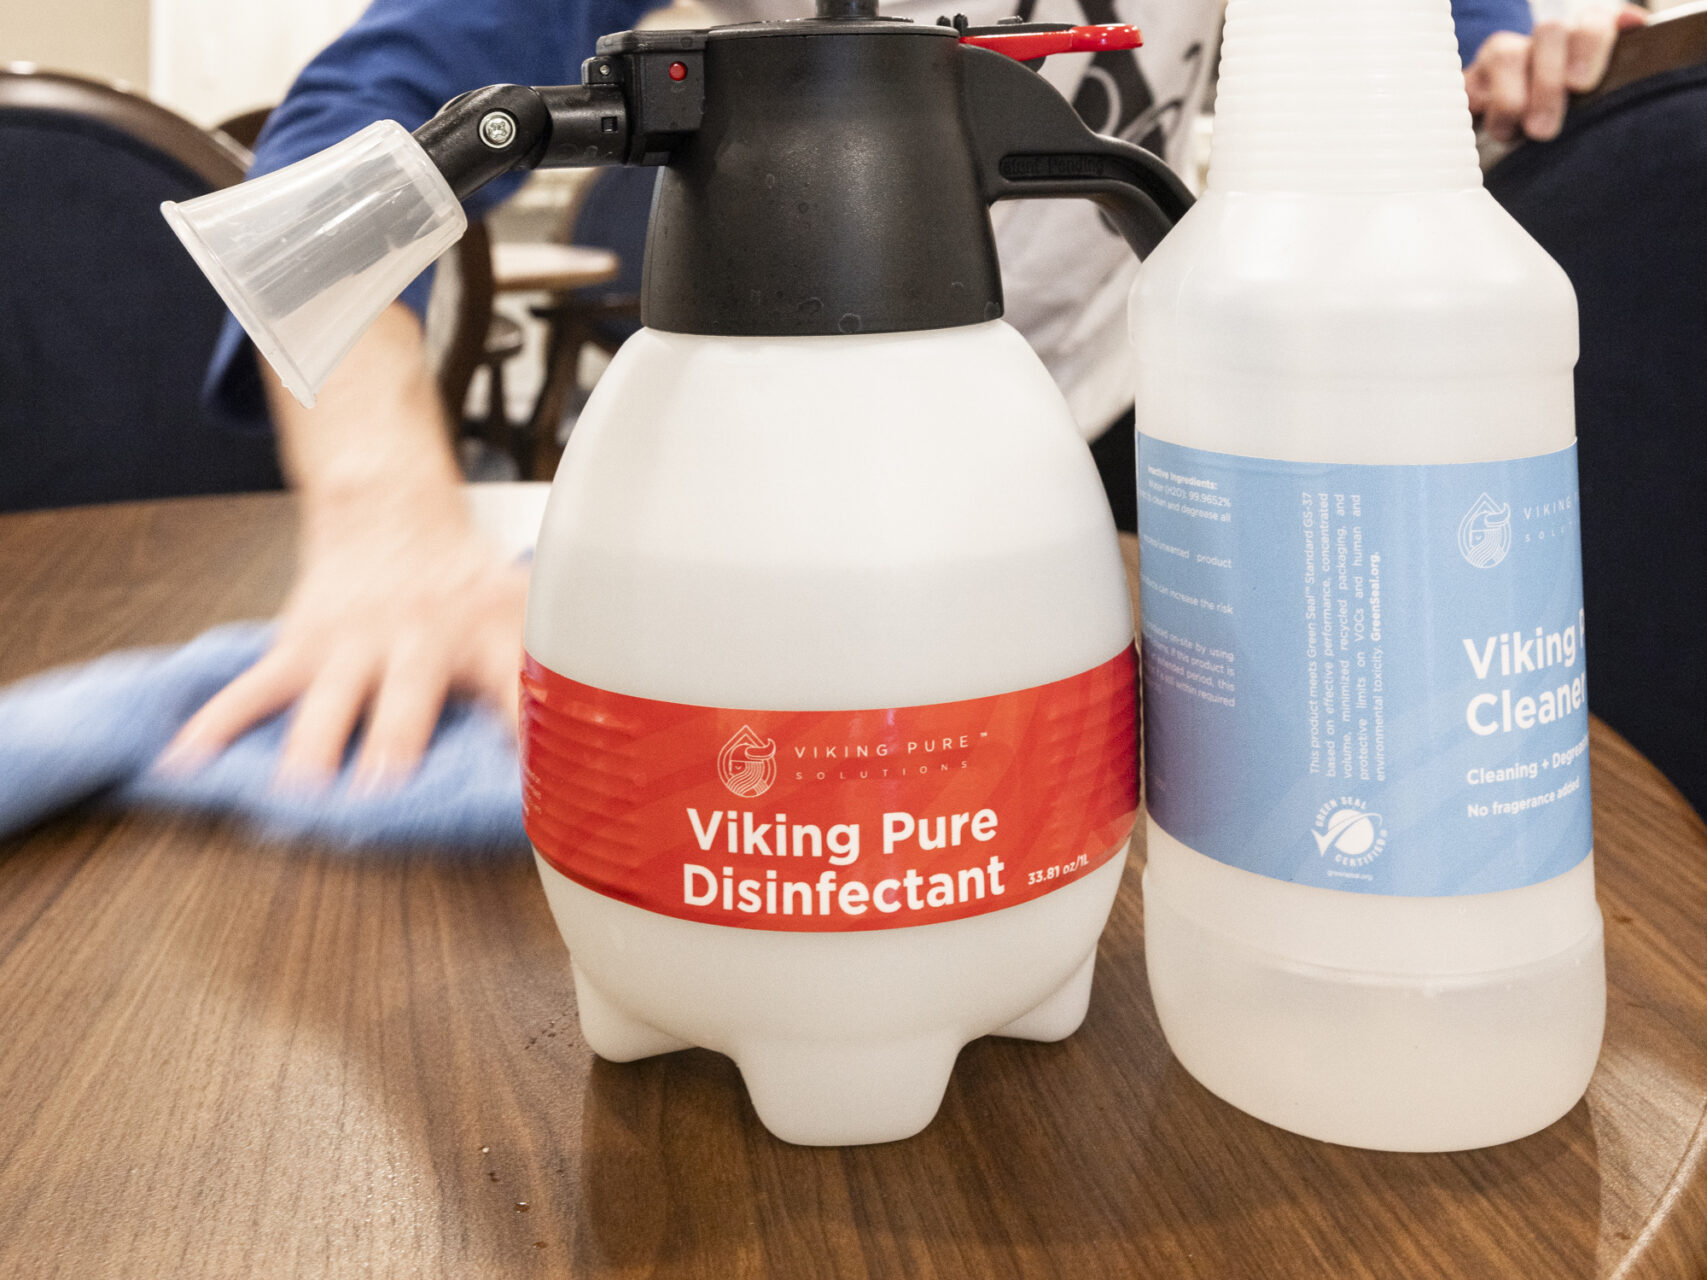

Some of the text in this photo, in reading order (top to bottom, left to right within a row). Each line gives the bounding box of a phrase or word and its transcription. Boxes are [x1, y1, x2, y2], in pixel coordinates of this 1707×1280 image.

[1181, 505, 1219, 518] degrease
[1221, 512, 1231, 522] all
[1302, 491, 1313, 528] GS-37
[1523, 496, 1571, 520] VIKING
[1318, 493, 1330, 572] concentrated
[1196, 553, 1232, 568] product
[1304, 530, 1315, 584] Standard
[1216, 602, 1233, 614] risk
[1195, 641, 1206, 654] by
[1307, 622, 1317, 658] Green
[1334, 494, 1352, 779] volume, minimized recycled packaging, and
[1350, 494, 1370, 780] protective limits on VOCs and human and
[1462, 627, 1576, 680] Viking
[1191, 657, 1224, 674] product
[1308, 661, 1318, 697] meets
[1371, 645, 1383, 692] toxicity.
[1322, 662, 1335, 714] effective
[1309, 700, 1321, 748] product
[1326, 719, 1335, 735] on
[1372, 696, 1385, 782] environmental
[794, 743, 889, 759] VIKING
[907, 735, 969, 754] PURE
[1309, 751, 1320, 774] This
[1323, 740, 1336, 777] based
[795, 760, 968, 780] SOLUTIONS
[1467, 761, 1538, 785] Cleaning
[1467, 776, 1580, 818] No fragerance added
[686, 808, 998, 866] Viking Pure
[683, 855, 1006, 916] Disinfectant
[1028, 853, 1090, 886] 33.81 oz/1L
